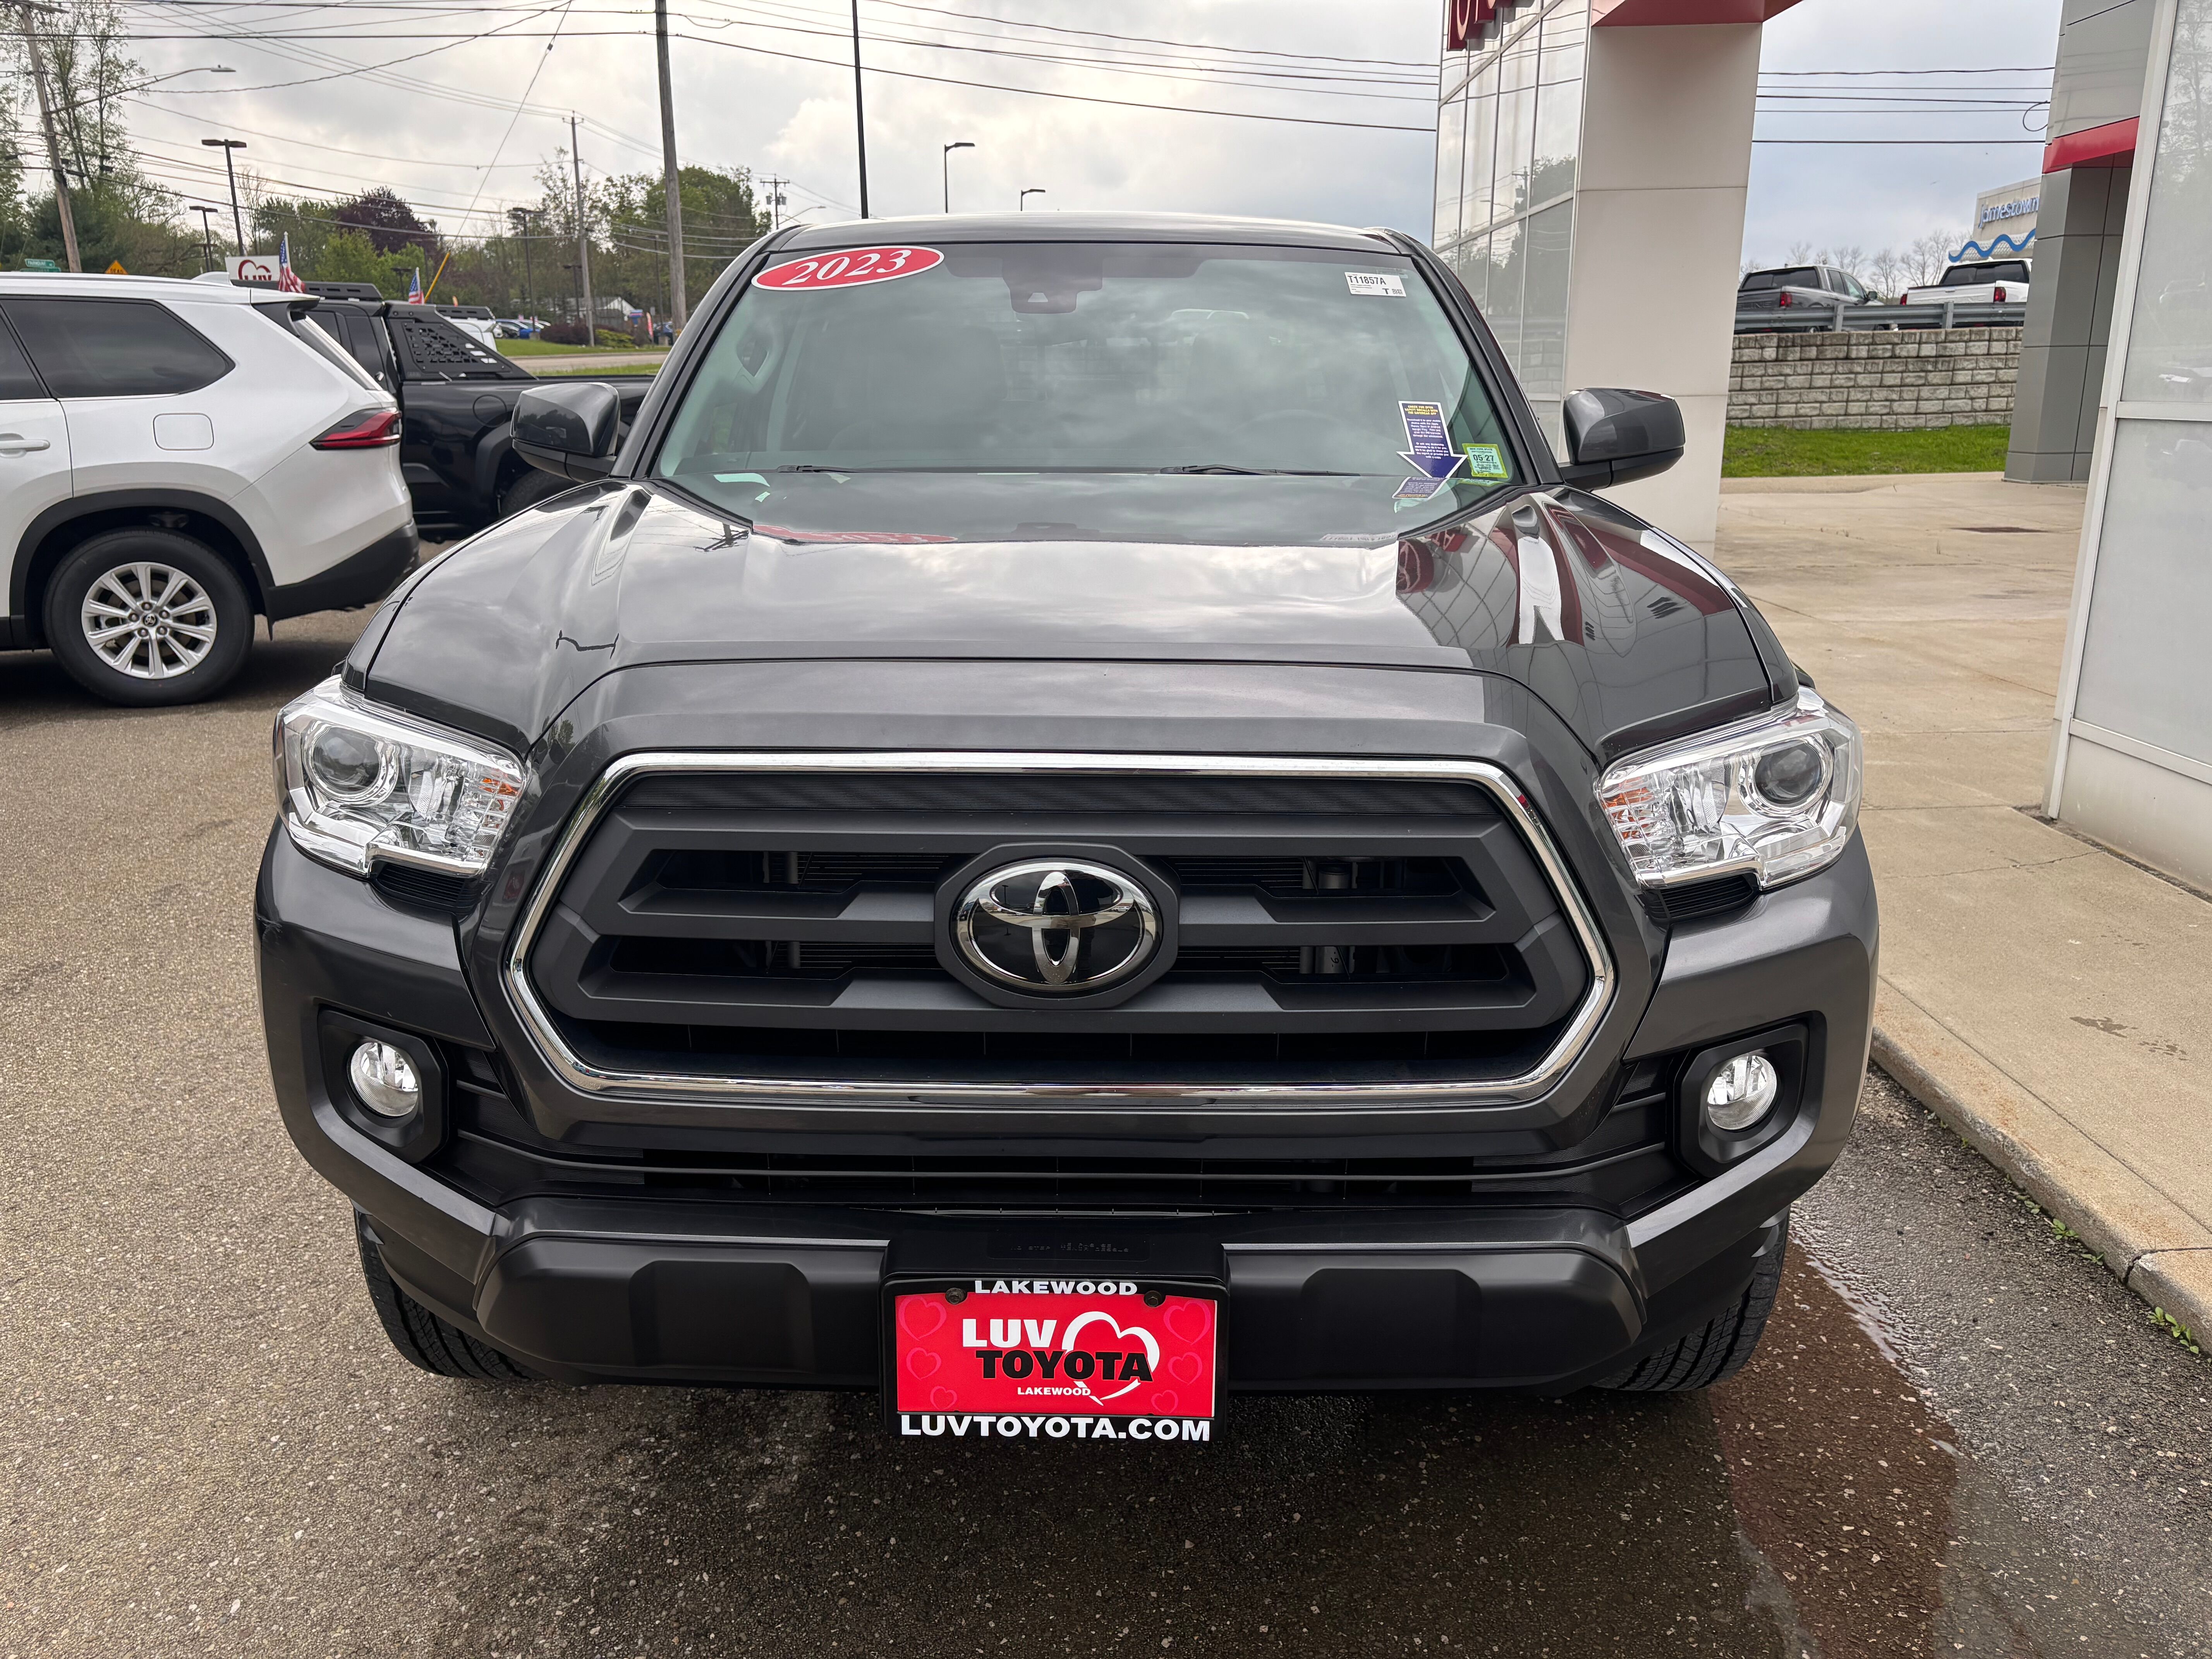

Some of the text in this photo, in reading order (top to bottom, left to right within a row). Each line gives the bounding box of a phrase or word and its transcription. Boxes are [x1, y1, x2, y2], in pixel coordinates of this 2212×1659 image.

[781, 249, 912, 285] 2023
[1347, 276, 1386, 285] T11857A
[975, 1280, 1137, 1295] LAKEWOOD
[962, 1318, 1057, 1348] LUV
[975, 1350, 1153, 1382] TOYOTA
[1017, 1387, 1091, 1396] LAKEWOOD
[901, 1415, 1210, 1441] LUVTOYOTA.COM
